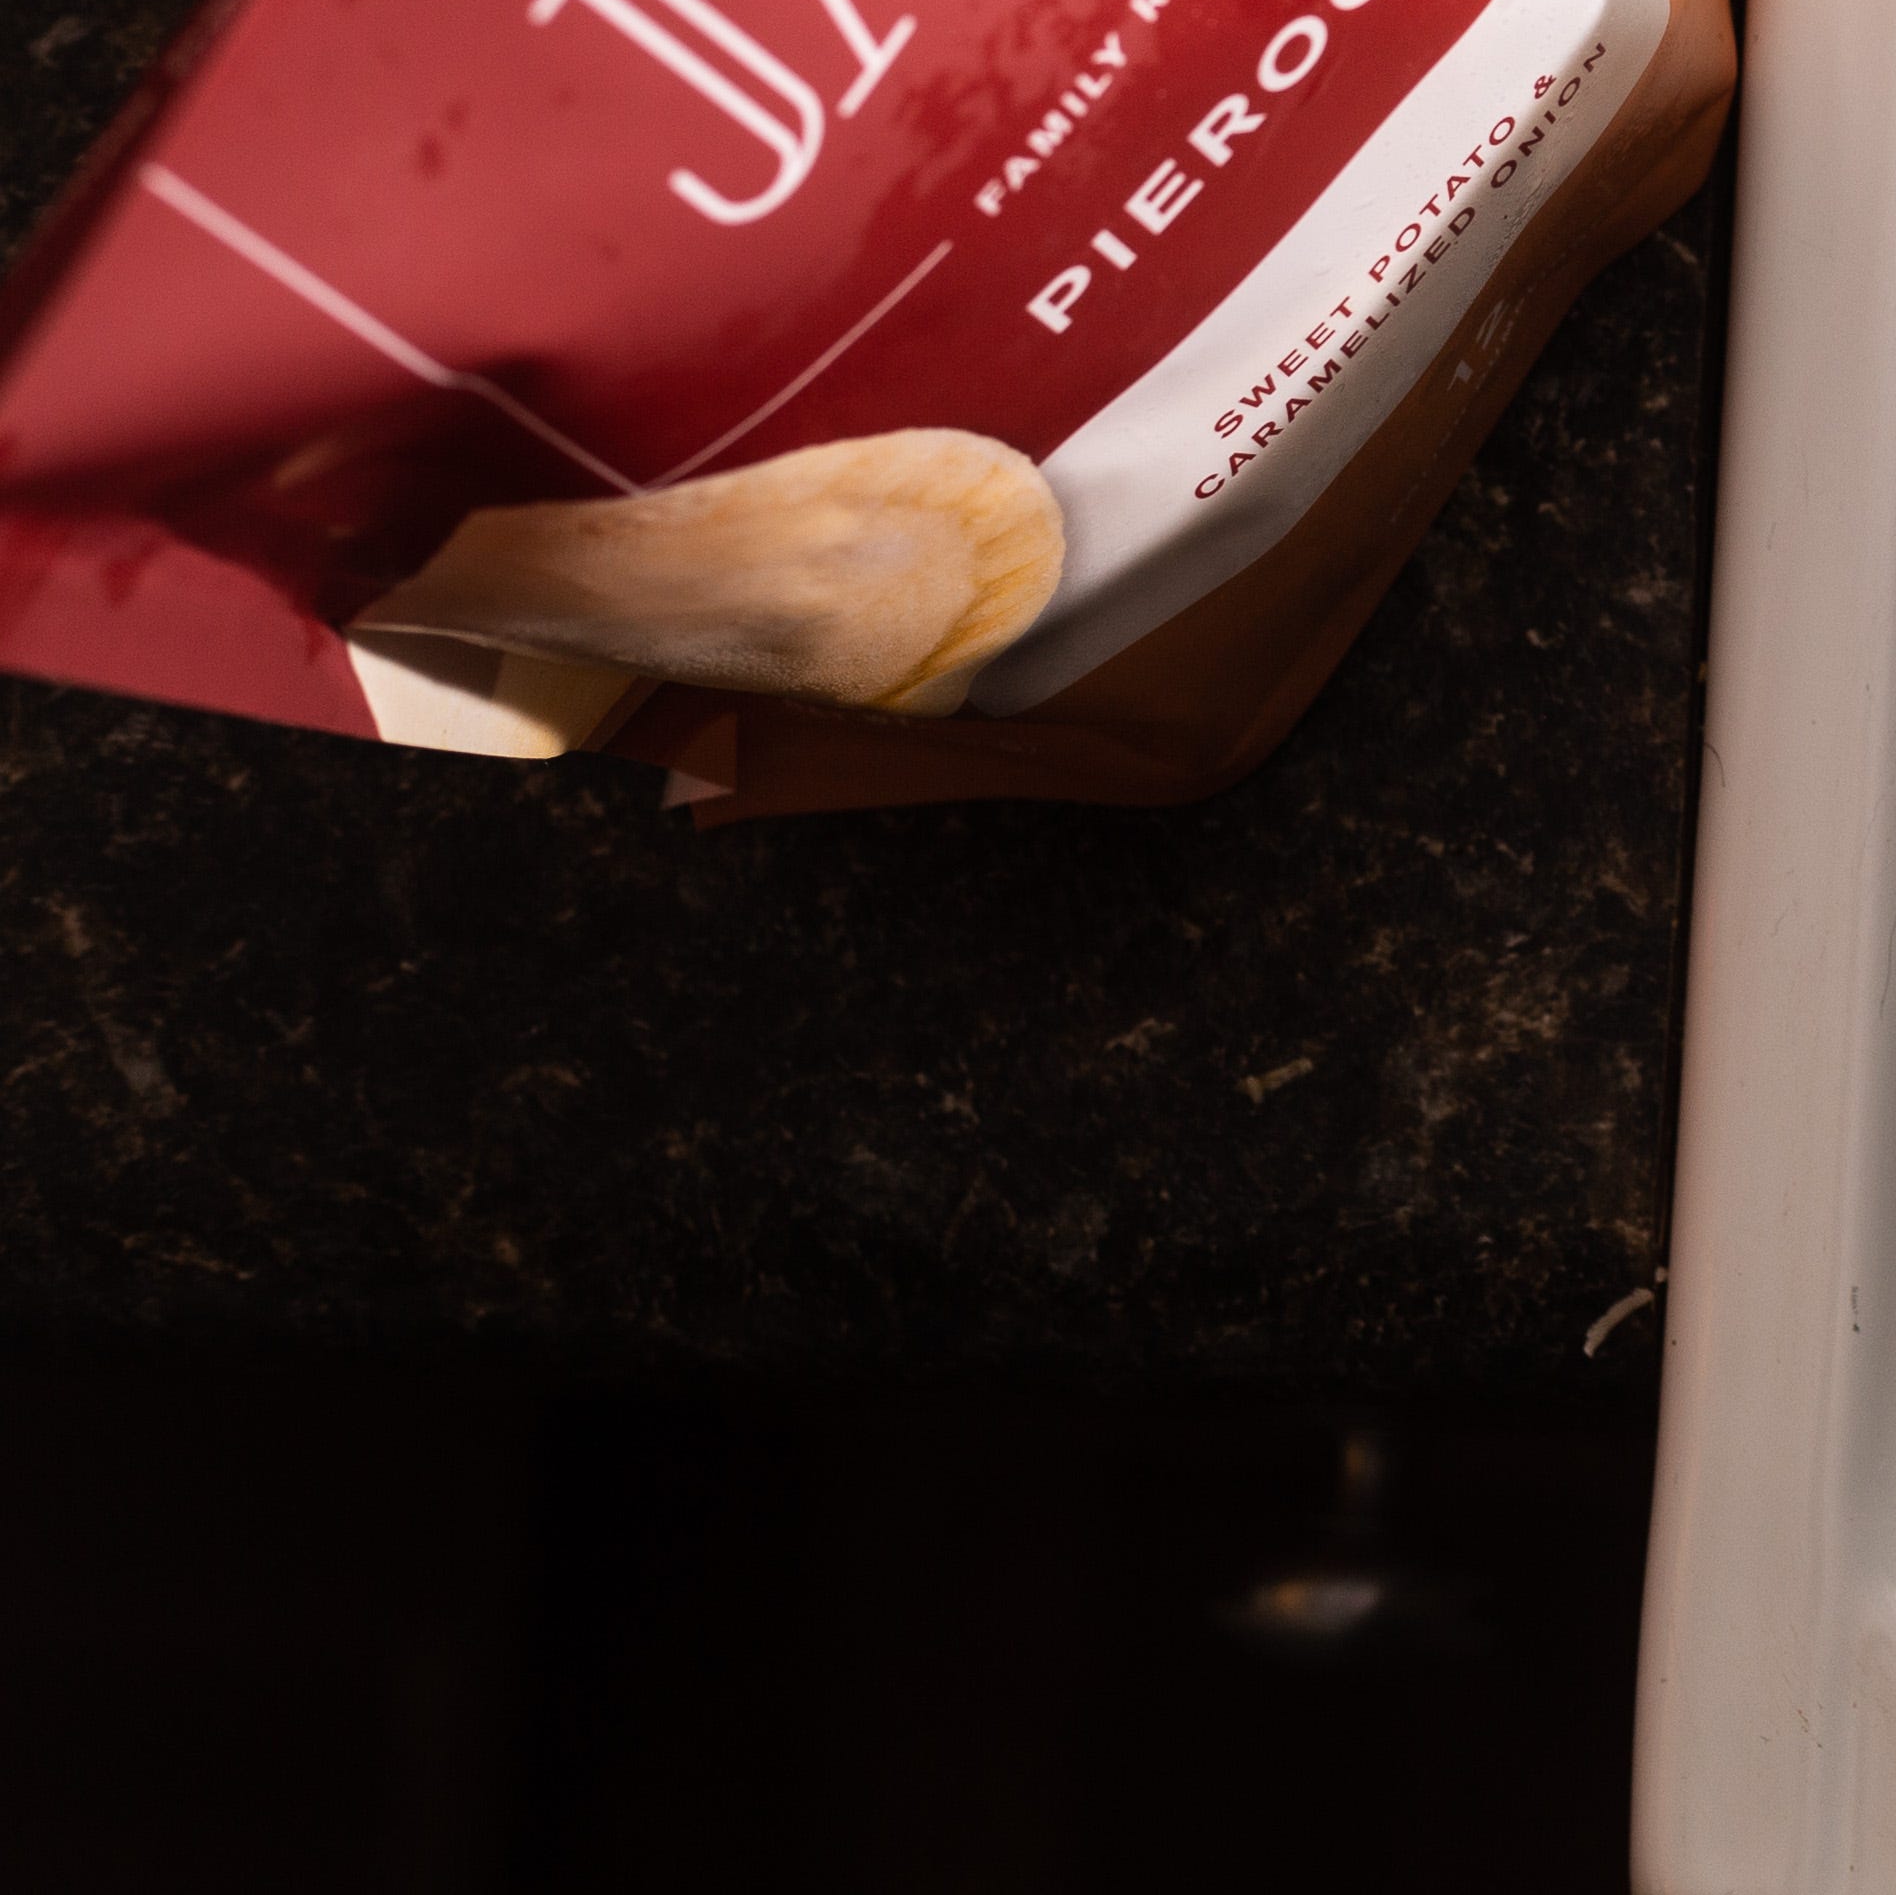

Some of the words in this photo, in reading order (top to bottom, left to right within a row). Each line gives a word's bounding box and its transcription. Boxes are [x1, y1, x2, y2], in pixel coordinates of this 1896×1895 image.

[974, 30, 1128, 218] FAMILY
[1213, 296, 1353, 440] SWEET
[1367, 115, 1516, 284] POTATO
[1533, 72, 1557, 101] &
[1193, 206, 1476, 501] CARAMELIZED
[1489, 41, 1607, 191] ONION
[1446, 297, 1508, 393] 12
